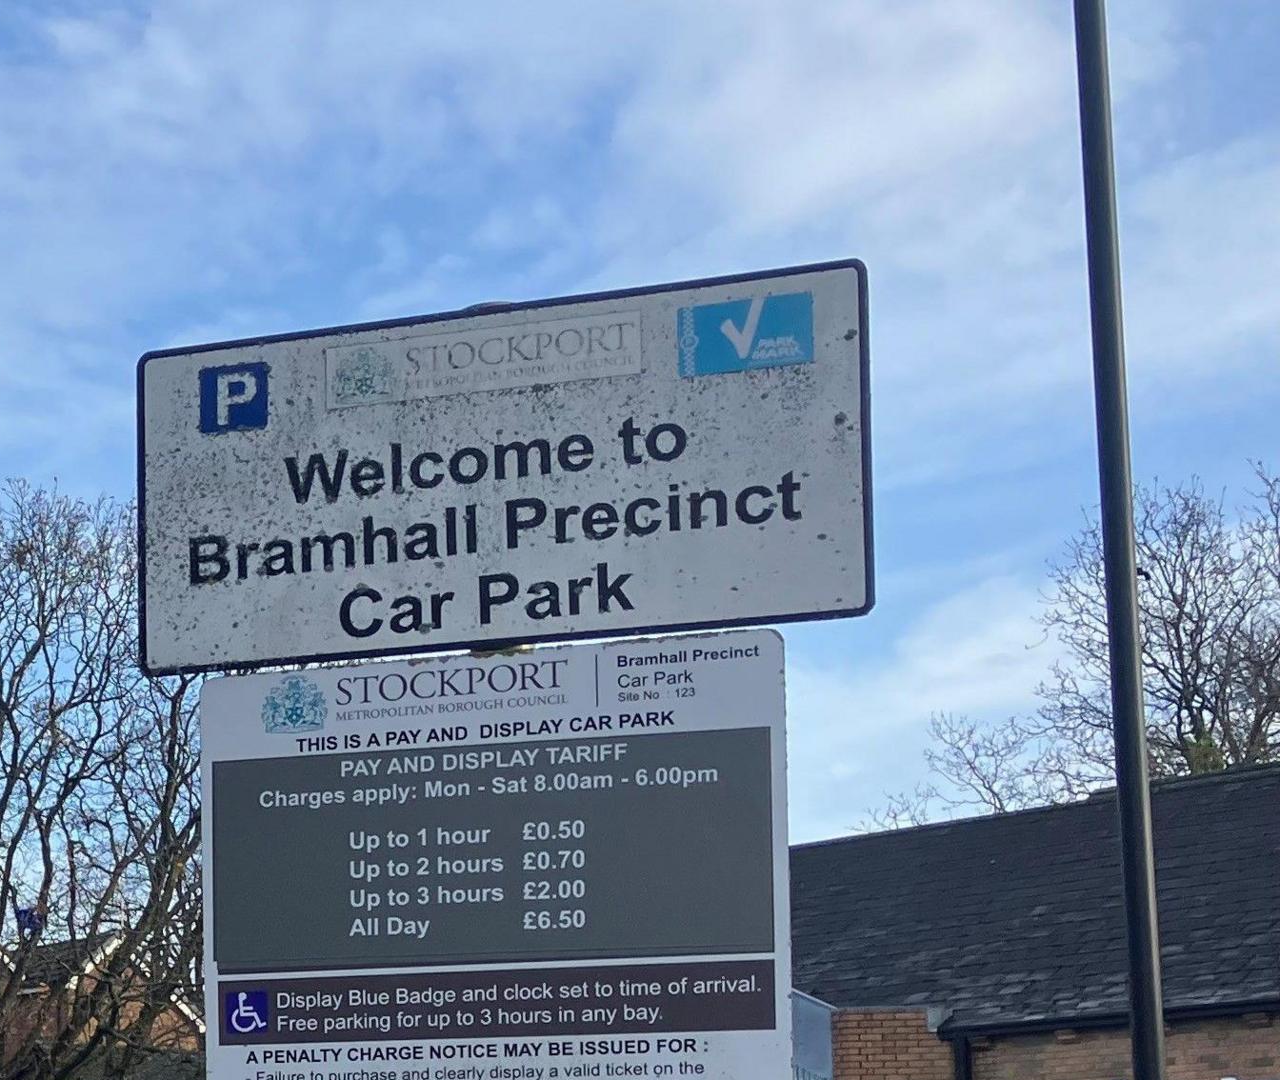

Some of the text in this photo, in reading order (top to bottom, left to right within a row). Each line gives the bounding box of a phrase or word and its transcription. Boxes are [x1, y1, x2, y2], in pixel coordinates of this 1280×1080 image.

[406, 323, 634, 374] STOCKPORT
[757, 335, 798, 349] PARK
[506, 361, 572, 380] BOROUGH
[574, 355, 633, 373] COUNCIL
[217, 371, 256, 424] P
[284, 419, 688, 504] Welcome to
[188, 471, 803, 586] Bramhall Precinct
[339, 563, 635, 638] Car Park
[617, 645, 759, 668] Bramhall Precinct
[335, 659, 569, 705] STOCKPORT
[617, 669, 693, 689] Car Park
[617, 686, 695, 703] Site No 123
[335, 693, 566, 721] METROPOLITAN BOROUGH COUNCIL
[295, 710, 674, 753] THIS IS A PAY AND DISPLAY CAR PARK
[341, 742, 627, 778] PAY AND DISPLAY TARIFF
[259, 790, 345, 809] Charges
[352, 783, 416, 806] apply:
[425, 780, 469, 798] Mon
[492, 776, 527, 794] Sat
[534, 772, 612, 792] 8.00am
[635, 766, 717, 788] 6.00pm
[349, 819, 584, 854] Up to 1 hour £0.50
[350, 849, 584, 883] Up to 2 hours £0.70
[350, 879, 585, 912] Up to 3 hours £2.00
[349, 909, 585, 939] All Day £6.50
[276, 974, 761, 1012] Display Blue Badge and clock set to time of arrival.
[277, 1003, 662, 1034] Free parking for up to 3 hours in any bay.
[246, 1050, 258, 1065] A
[263, 1048, 342, 1064] PENALTY
[347, 1045, 423, 1062] CHARGE
[429, 1043, 497, 1060] NOTICE
[503, 1042, 542, 1058] MAY
[548, 1041, 573, 1057] BE
[579, 1039, 650, 1056] ISSUED
[656, 1038, 696, 1054] FOR
